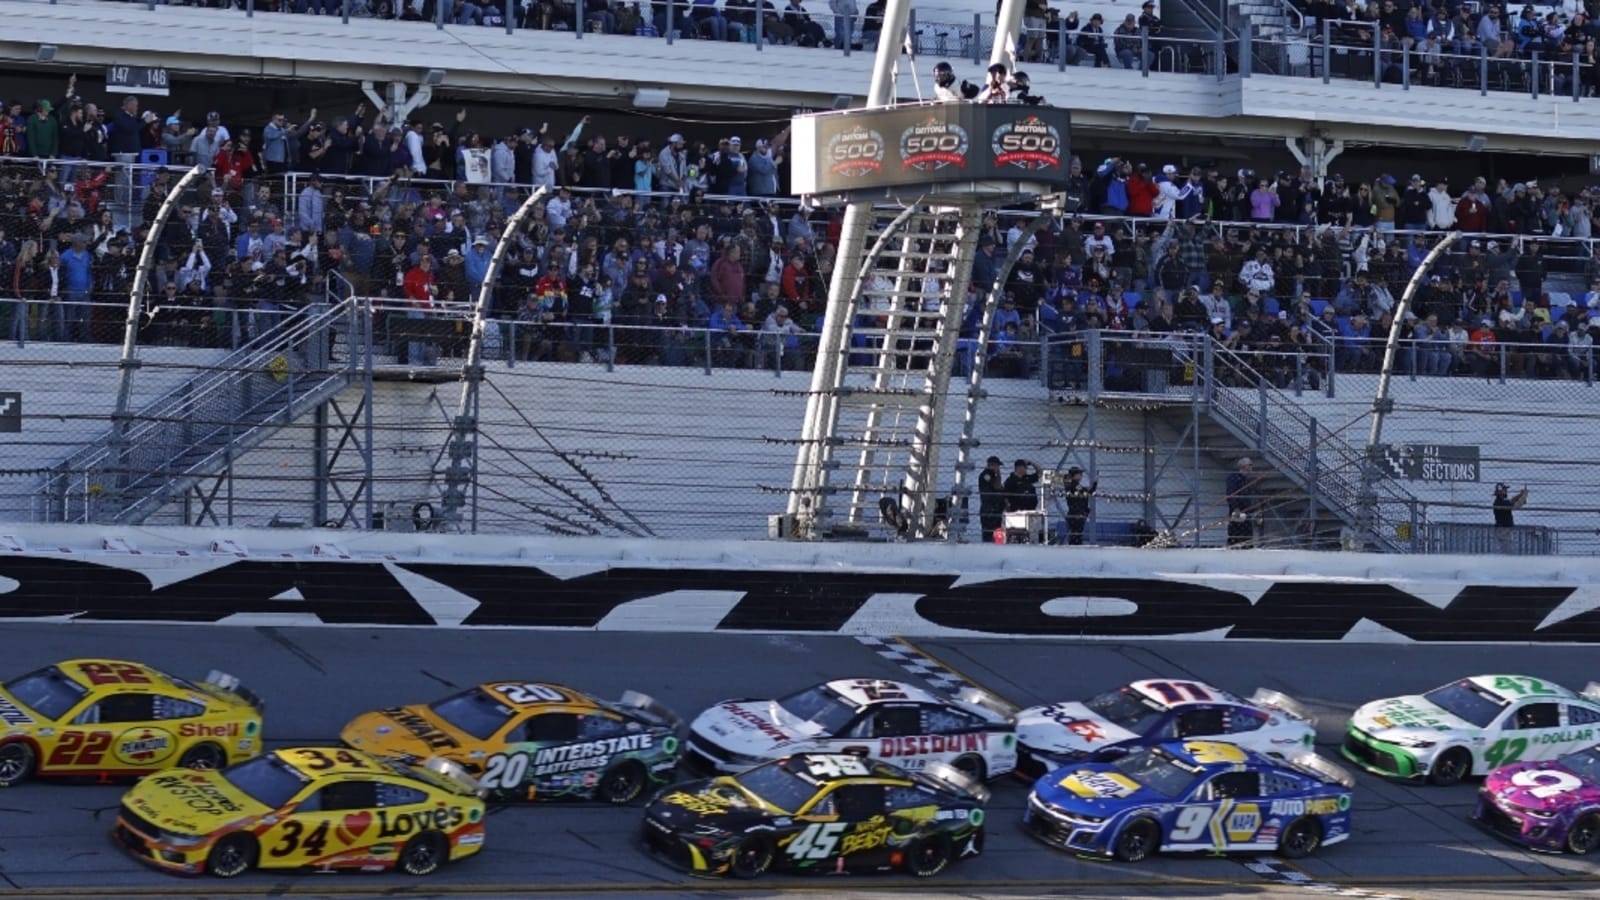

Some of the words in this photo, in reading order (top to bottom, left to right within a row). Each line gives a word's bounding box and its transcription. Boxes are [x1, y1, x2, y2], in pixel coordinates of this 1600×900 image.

[112, 67, 129, 83] 147
[147, 69, 166, 85] 146
[915, 125, 946, 135] DAYTONA
[1014, 125, 1047, 134] DAYTONA
[834, 143, 878, 161] 500
[906, 135, 960, 154] 500
[1001, 134, 1057, 153] 500
[1422, 463, 1476, 481] SECTIONS
[78, 662, 153, 686] 22
[495, 683, 567, 704] 20
[1145, 681, 1213, 703] 11
[1494, 676, 1557, 696] 42
[178, 722, 238, 742] Shell
[1541, 729, 1594, 745] DOLLAR
[47, 731, 113, 766] 22
[535, 733, 653, 765] INTERSTATE
[879, 733, 988, 758] DISCOUNT
[1483, 737, 1528, 770] 42
[296, 751, 369, 771] 34
[535, 755, 609, 776] BATTERIES
[481, 754, 529, 789] 20
[1270, 799, 1305, 816] AUTO
[1169, 806, 1213, 841] 9
[1231, 814, 1258, 831] NAPA
[269, 820, 330, 857] 34
[786, 822, 848, 860] 45
